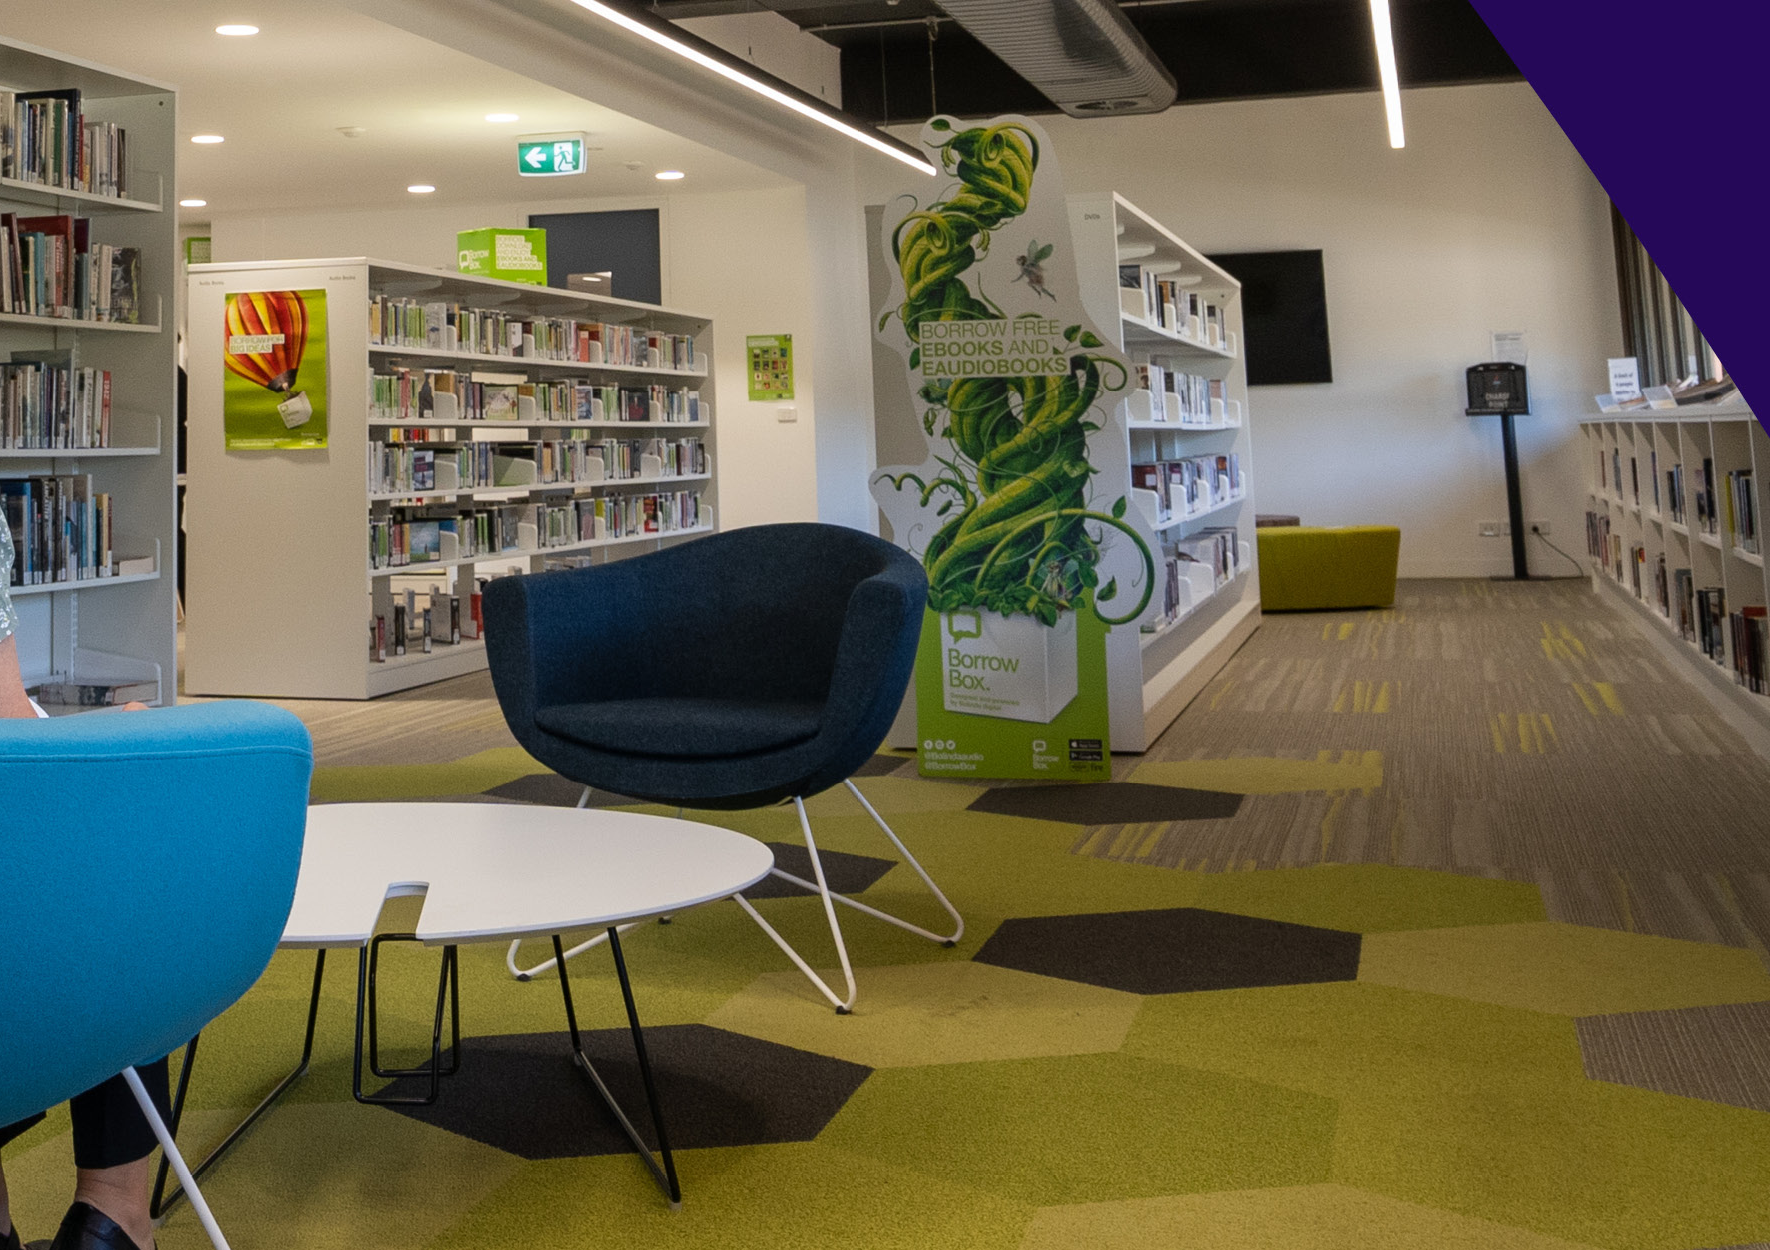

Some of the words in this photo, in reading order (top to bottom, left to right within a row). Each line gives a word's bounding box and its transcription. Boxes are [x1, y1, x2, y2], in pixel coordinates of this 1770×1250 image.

[231, 335, 267, 344] BORROW
[921, 321, 1007, 340] BORROW
[1012, 319, 1061, 336] FREE
[231, 344, 246, 353] BIG
[246, 344, 272, 352] IDEAS
[921, 340, 1004, 358] EBOOKS
[1009, 339, 1049, 355] AND
[922, 356, 1068, 376] EAUDIOBOOKS
[948, 647, 1020, 673] Borrow
[949, 669, 991, 692] Box.
